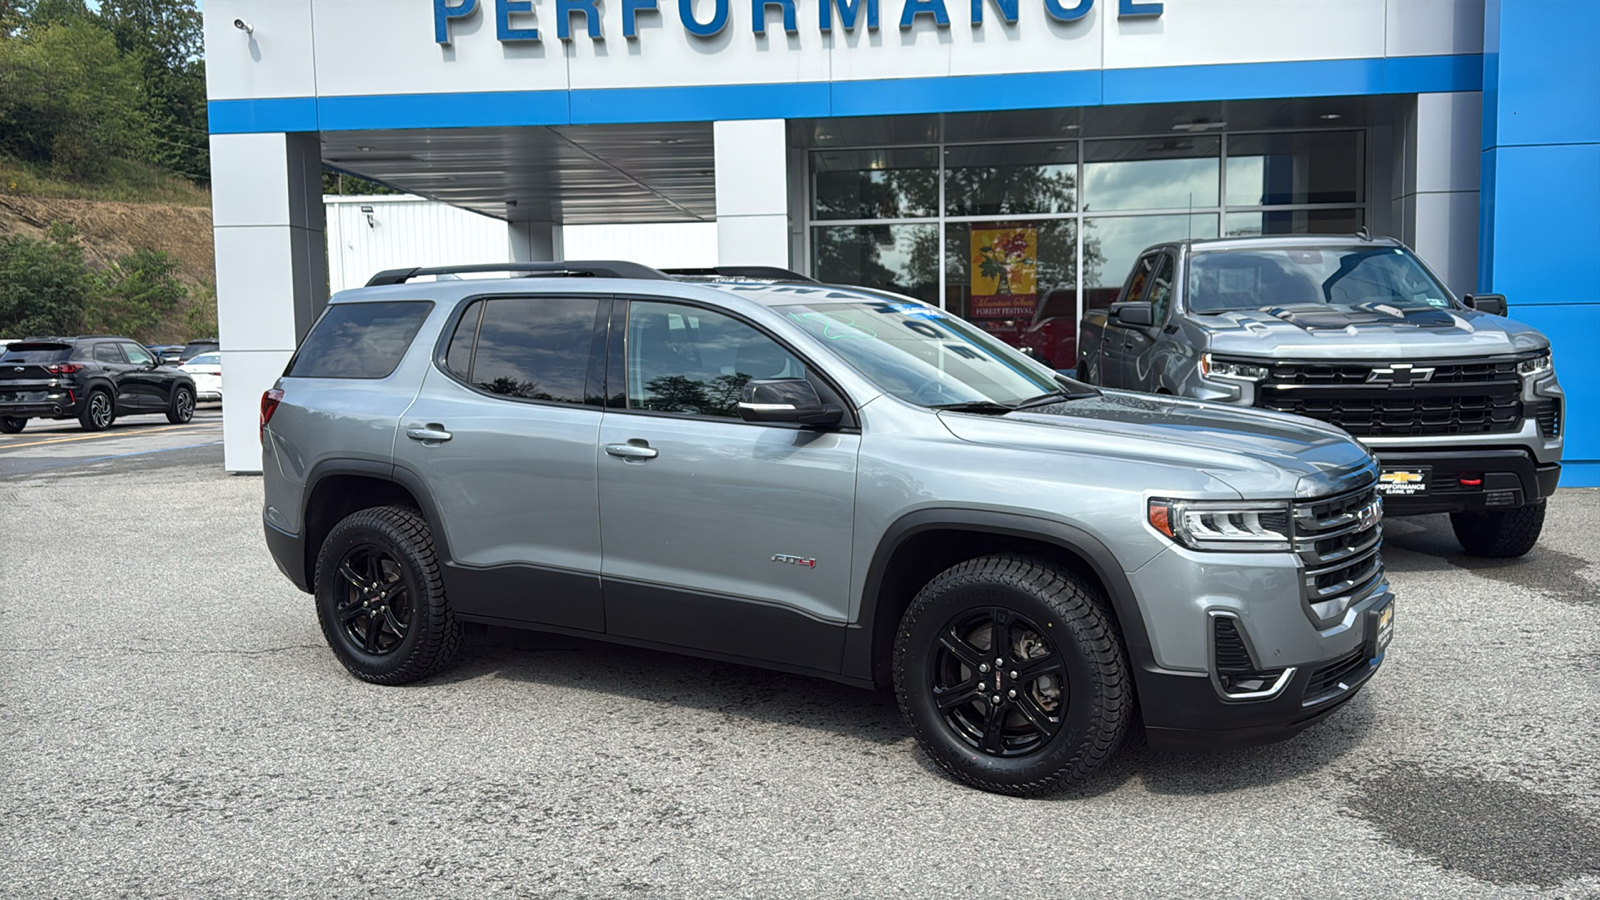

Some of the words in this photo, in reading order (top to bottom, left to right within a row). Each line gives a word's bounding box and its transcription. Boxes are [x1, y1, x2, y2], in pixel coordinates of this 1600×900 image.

[433, 0, 1163, 46] PERFORM
[976, 307, 1001, 315] FOREST
[1002, 306, 1034, 314] FESTIVAL
[1375, 483, 1426, 491] PERFORMANCE
[770, 553, 817, 569] AT4
